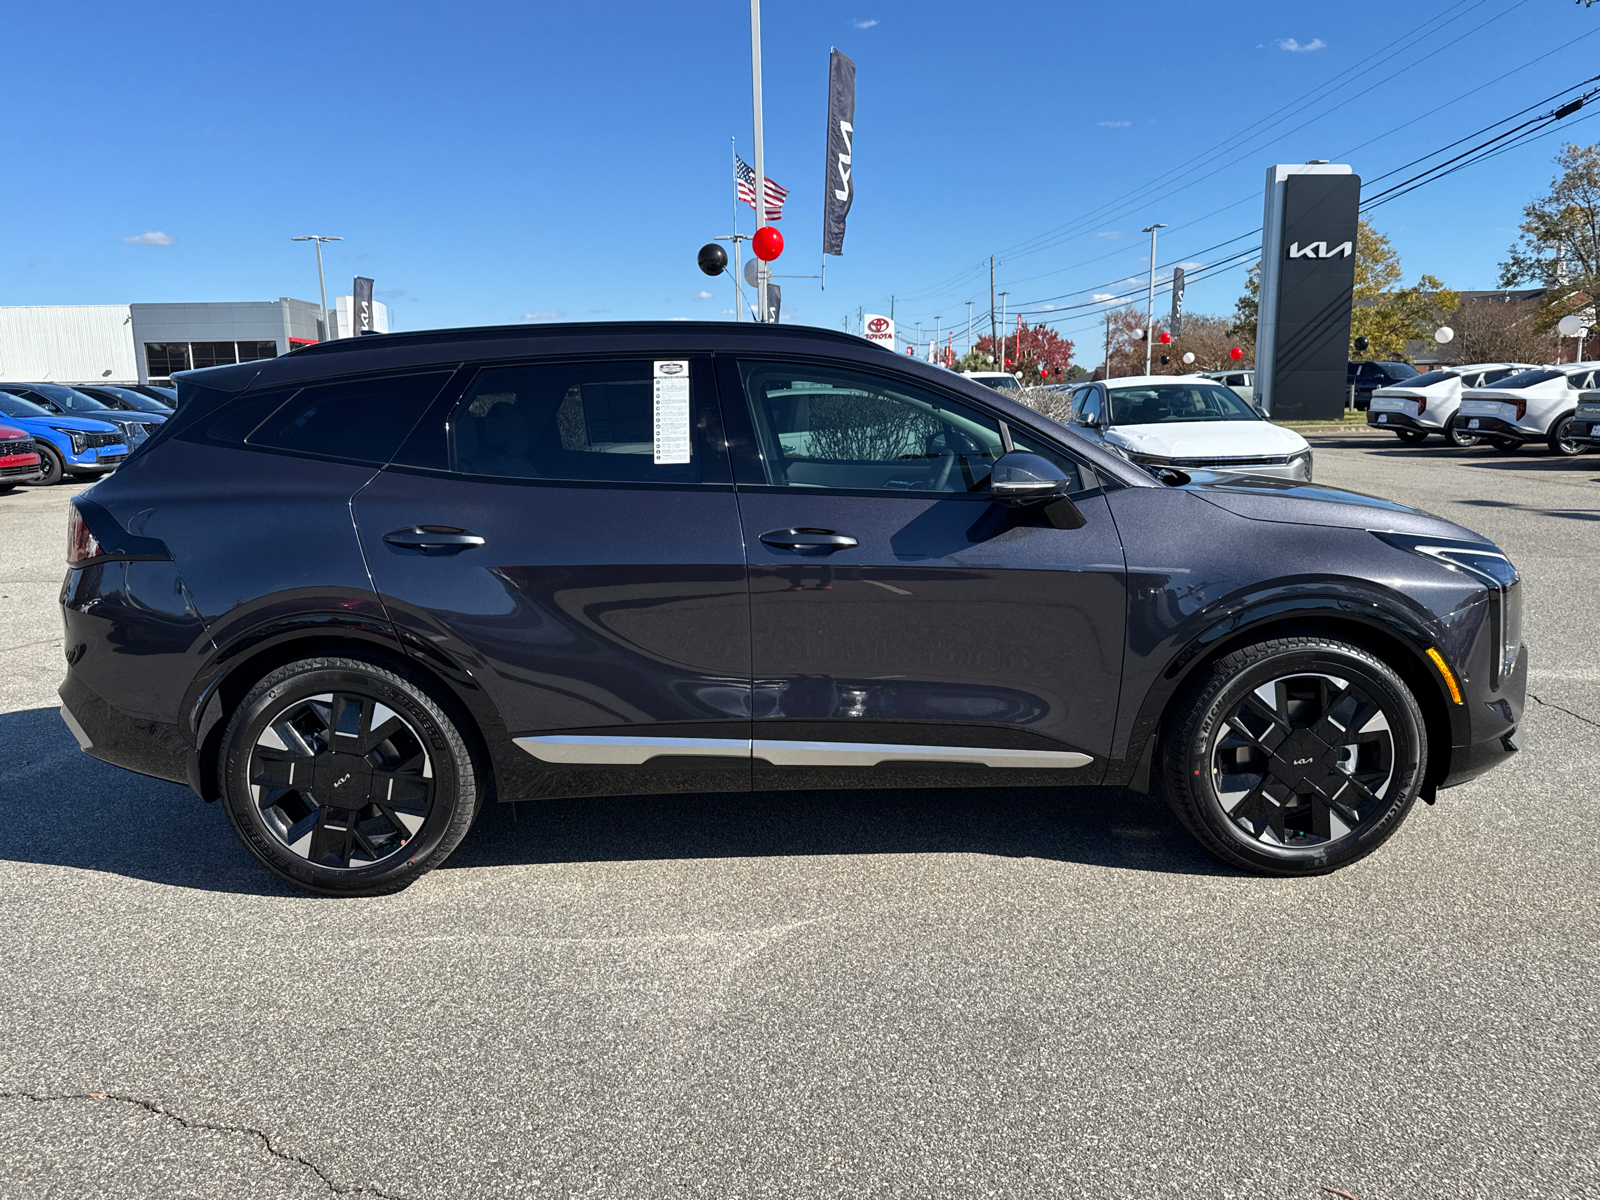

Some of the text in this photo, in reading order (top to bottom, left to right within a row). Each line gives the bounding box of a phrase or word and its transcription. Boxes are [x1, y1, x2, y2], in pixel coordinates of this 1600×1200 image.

[835, 120, 853, 201] KIA
[1289, 241, 1352, 258] KIA
[1293, 757, 1313, 765] KIA
[333, 773, 351, 788] KIA
